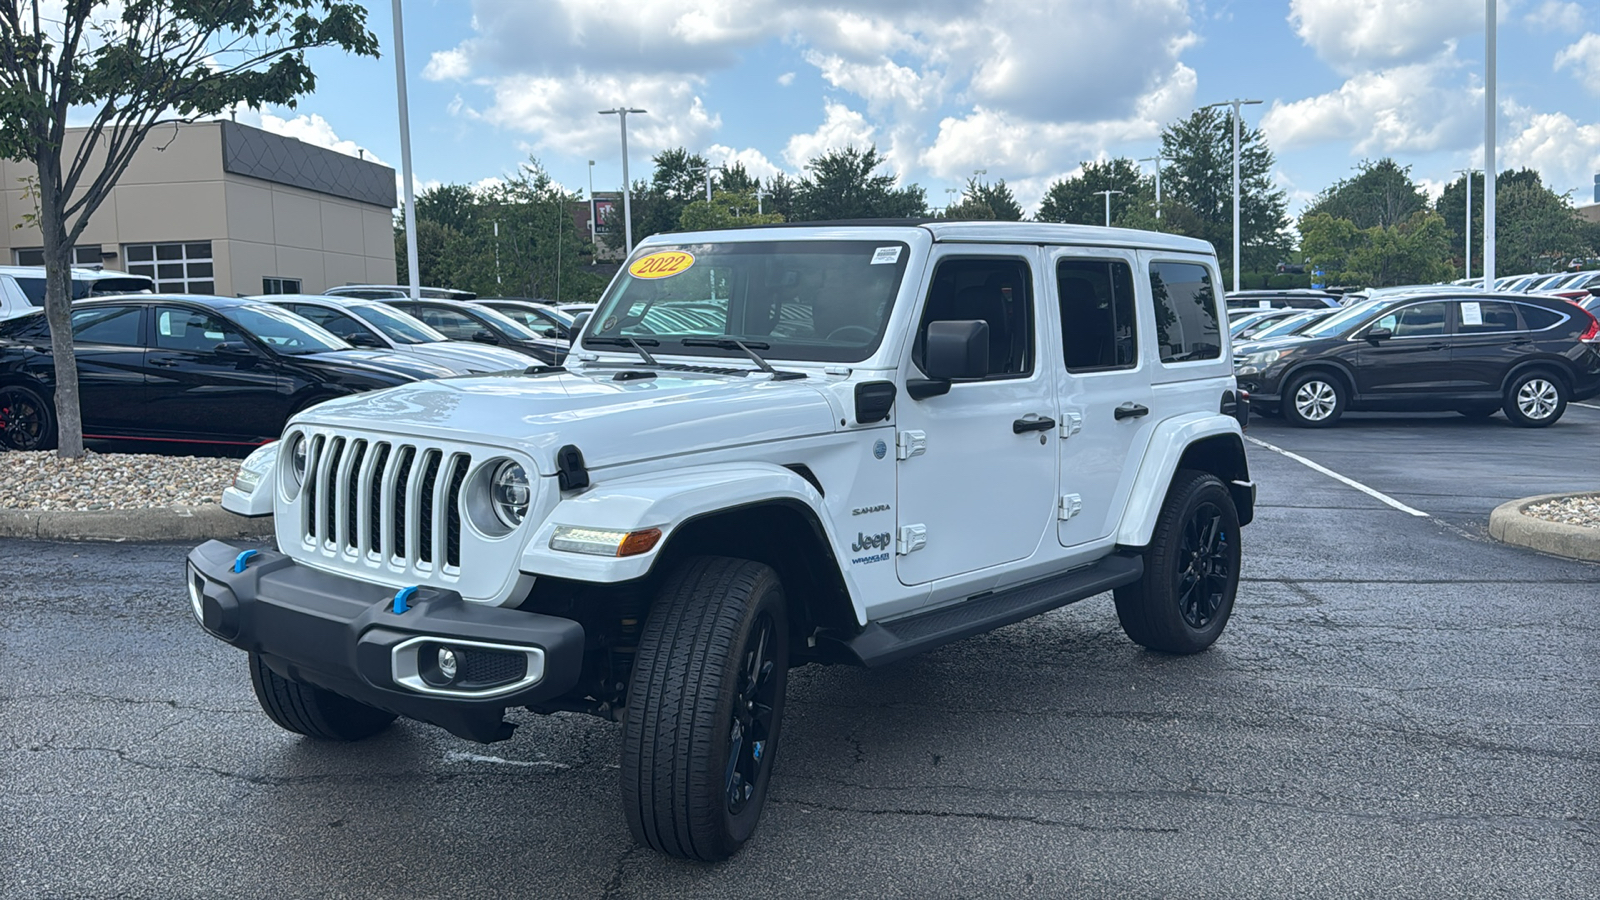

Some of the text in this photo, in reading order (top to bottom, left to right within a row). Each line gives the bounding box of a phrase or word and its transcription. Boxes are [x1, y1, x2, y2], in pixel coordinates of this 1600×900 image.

[636, 255, 686, 273] 2022
[852, 504, 890, 516] SAHARA
[851, 532, 891, 552] Jeep
[851, 552, 890, 564] WRANGLER
